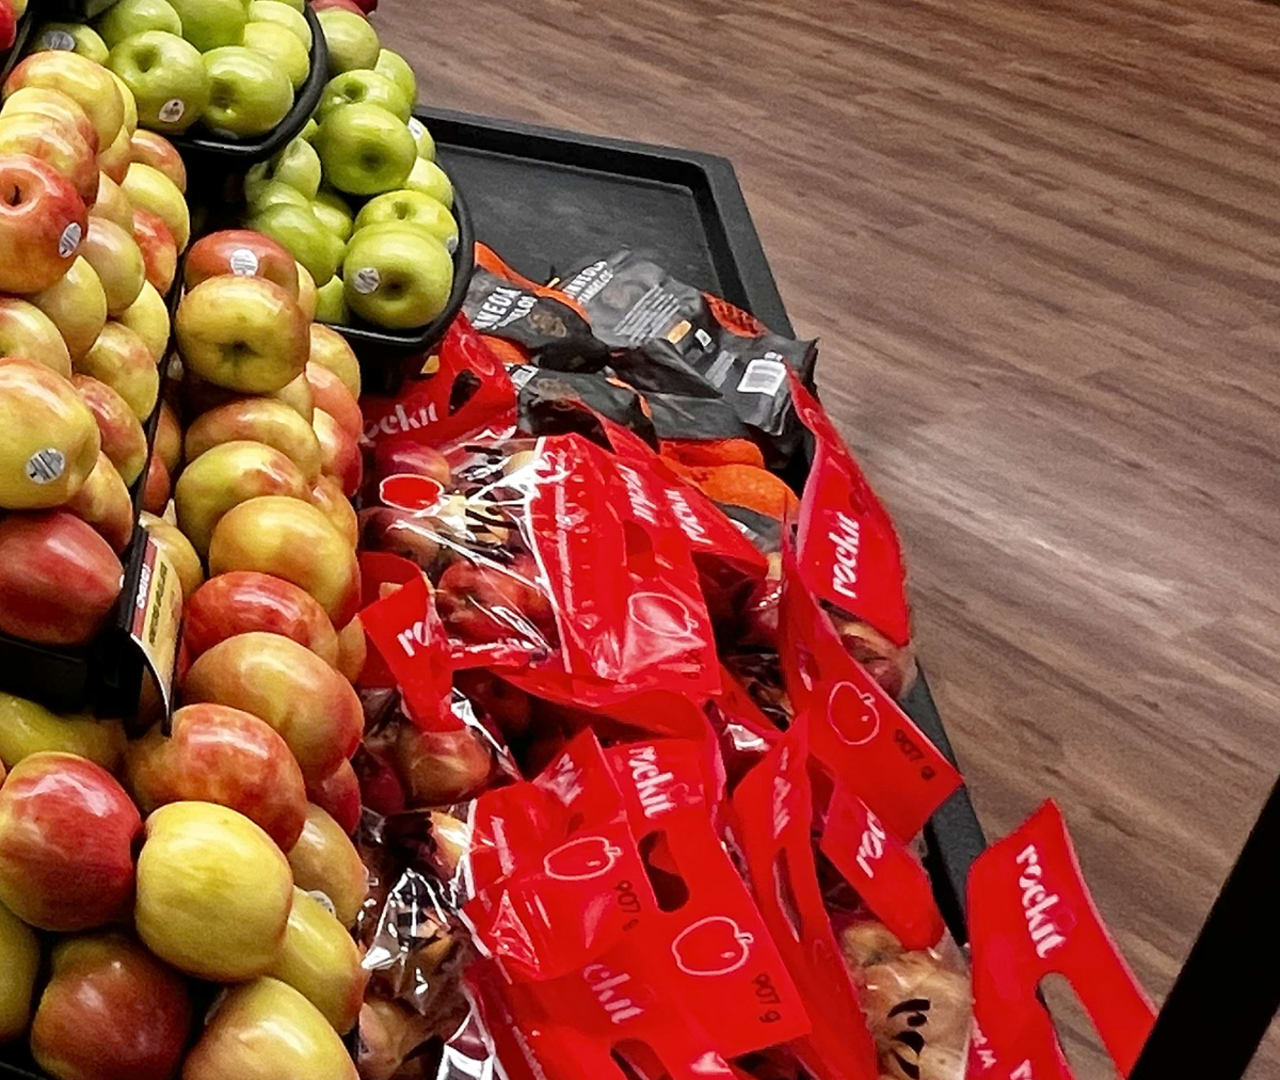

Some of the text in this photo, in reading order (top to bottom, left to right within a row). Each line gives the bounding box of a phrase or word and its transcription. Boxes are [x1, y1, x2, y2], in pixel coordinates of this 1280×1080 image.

[831, 510, 860, 599] rockit
[628, 746, 678, 819] rockit
[1014, 843, 1068, 959] rockit
[751, 972, 782, 1005] 907
